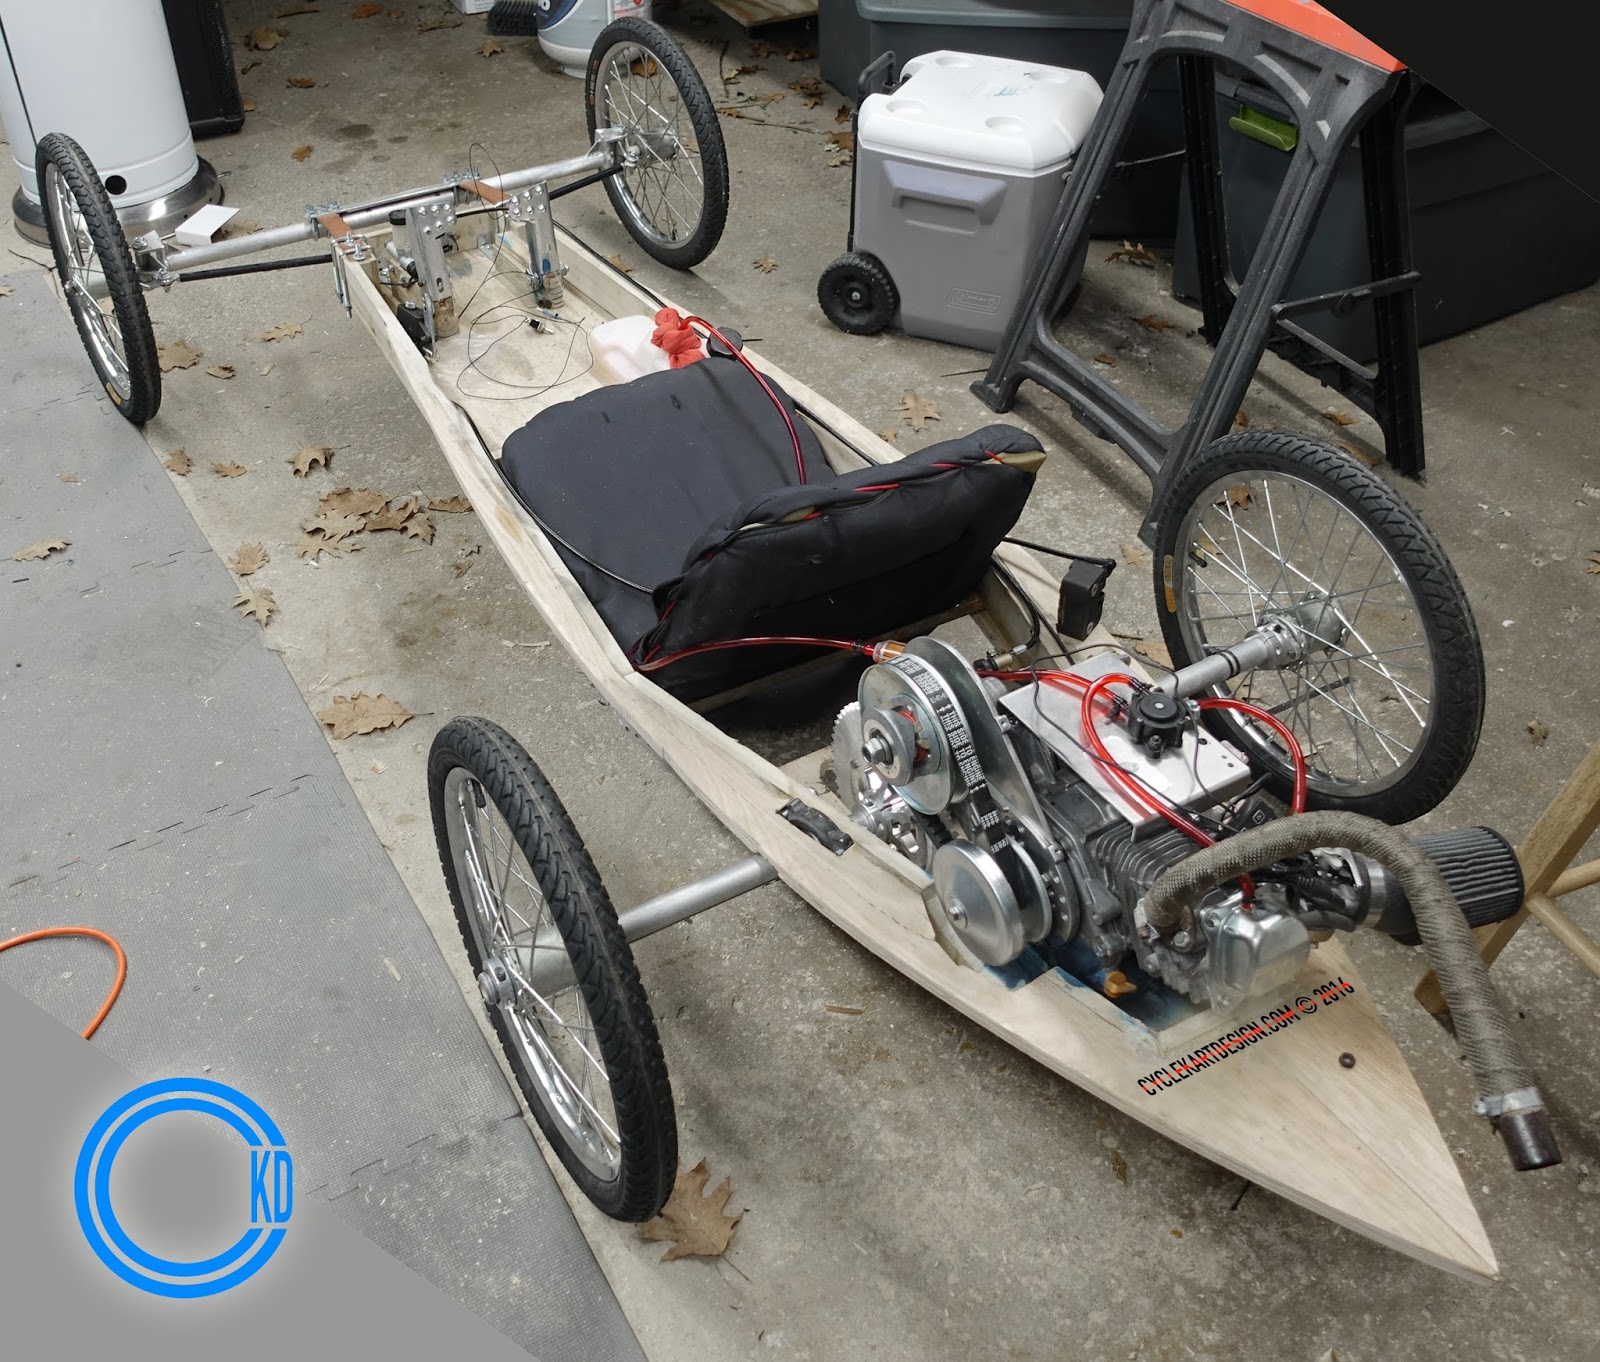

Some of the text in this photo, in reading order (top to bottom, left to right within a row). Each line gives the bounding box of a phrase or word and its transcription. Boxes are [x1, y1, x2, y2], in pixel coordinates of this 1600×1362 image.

[941, 712, 955, 730] THIS
[949, 730, 962, 748] SIDE
[957, 747, 967, 759] TO
[962, 758, 977, 785] ENGINE
[947, 709, 983, 782] THIS SIDE TO ENGINE
